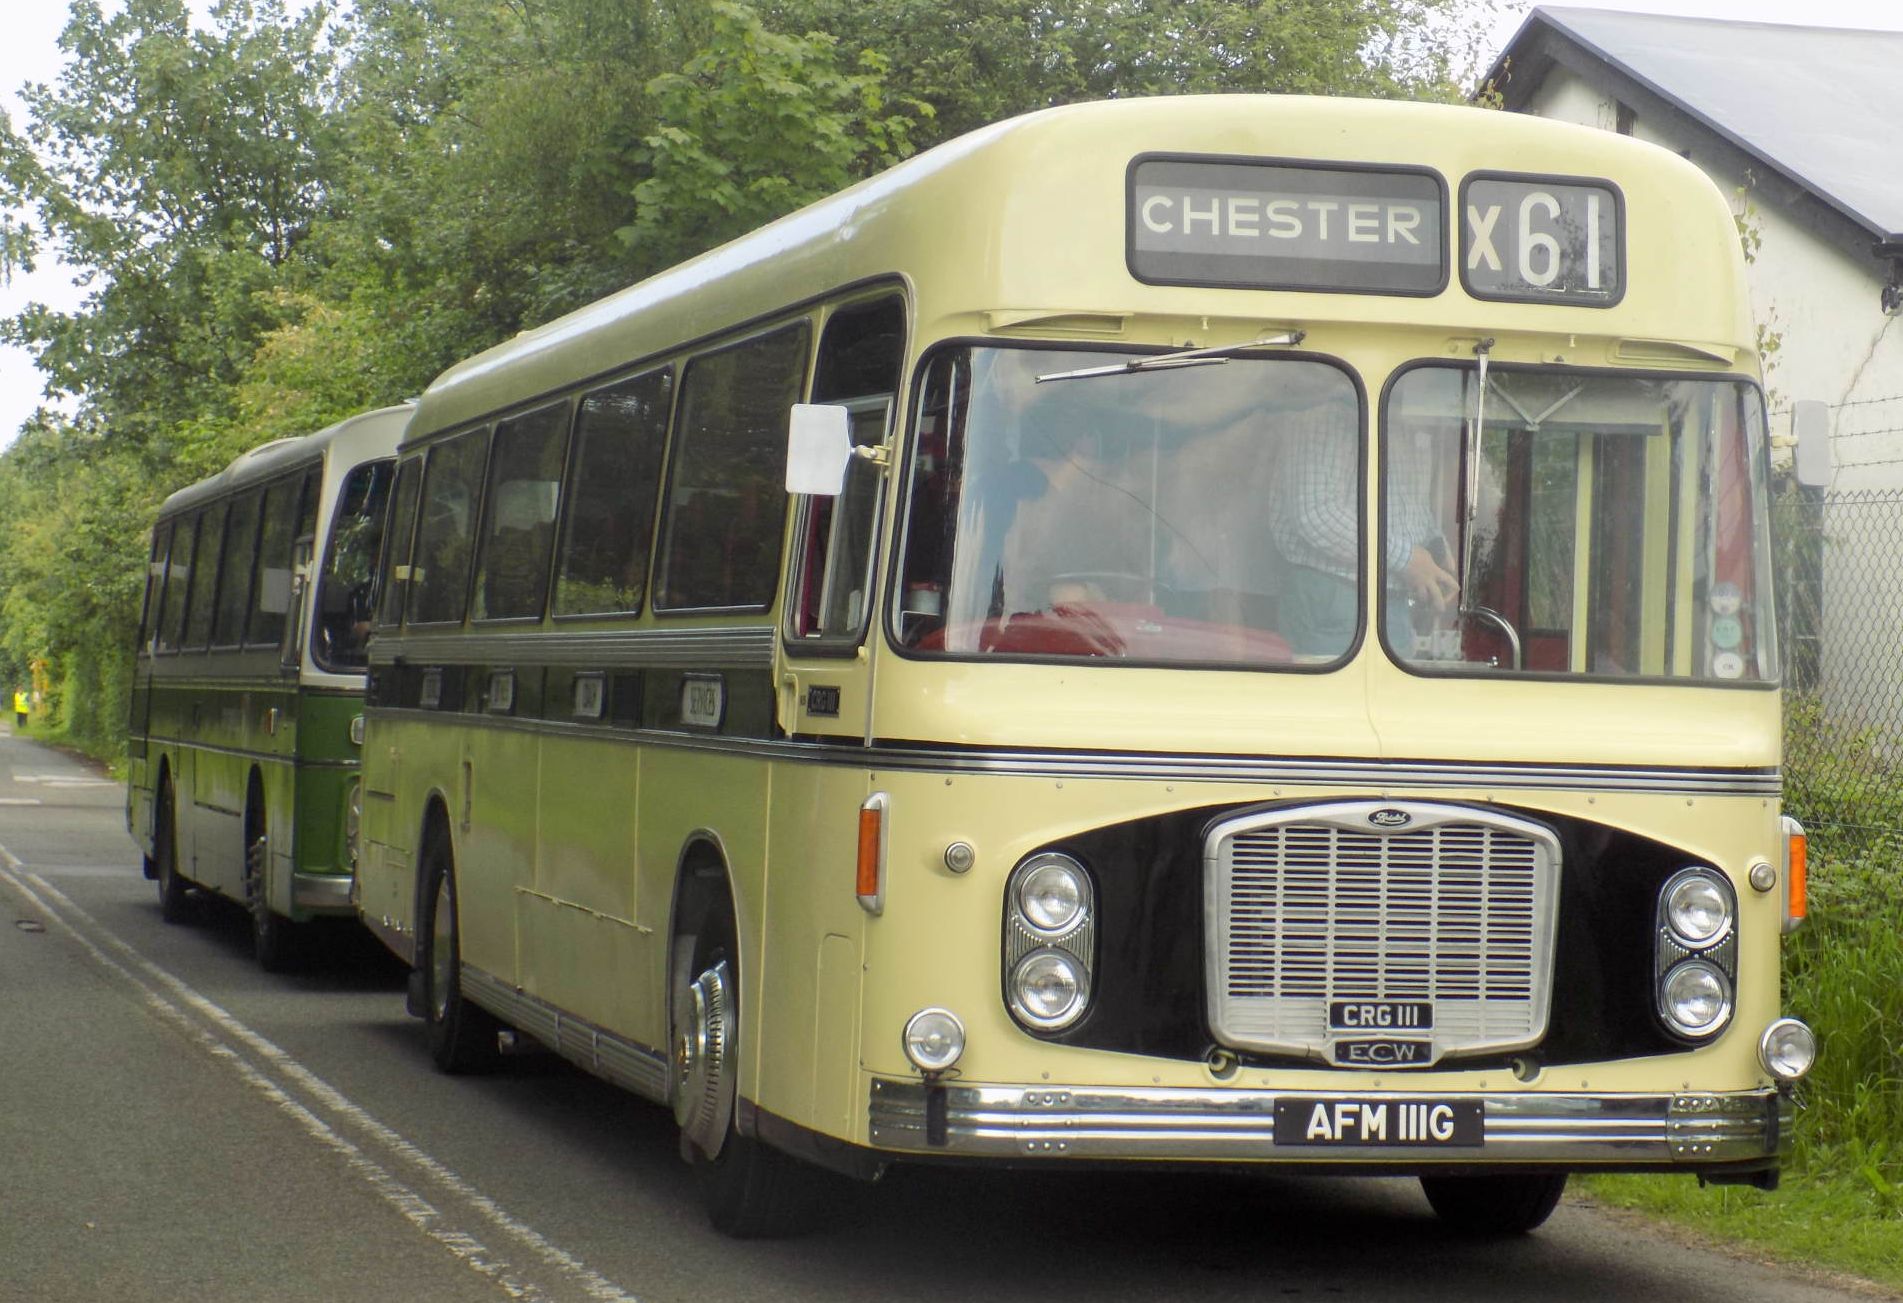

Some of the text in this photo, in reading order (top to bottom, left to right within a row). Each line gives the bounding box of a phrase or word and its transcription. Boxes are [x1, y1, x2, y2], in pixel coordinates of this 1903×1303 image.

[1141, 194, 1421, 245] CHESTER
[1467, 191, 1600, 289] X61
[1343, 1004, 1392, 1027] CRG
[1349, 1043, 1416, 1063] ECW
[1306, 1102, 1455, 1142] AFM 111G
